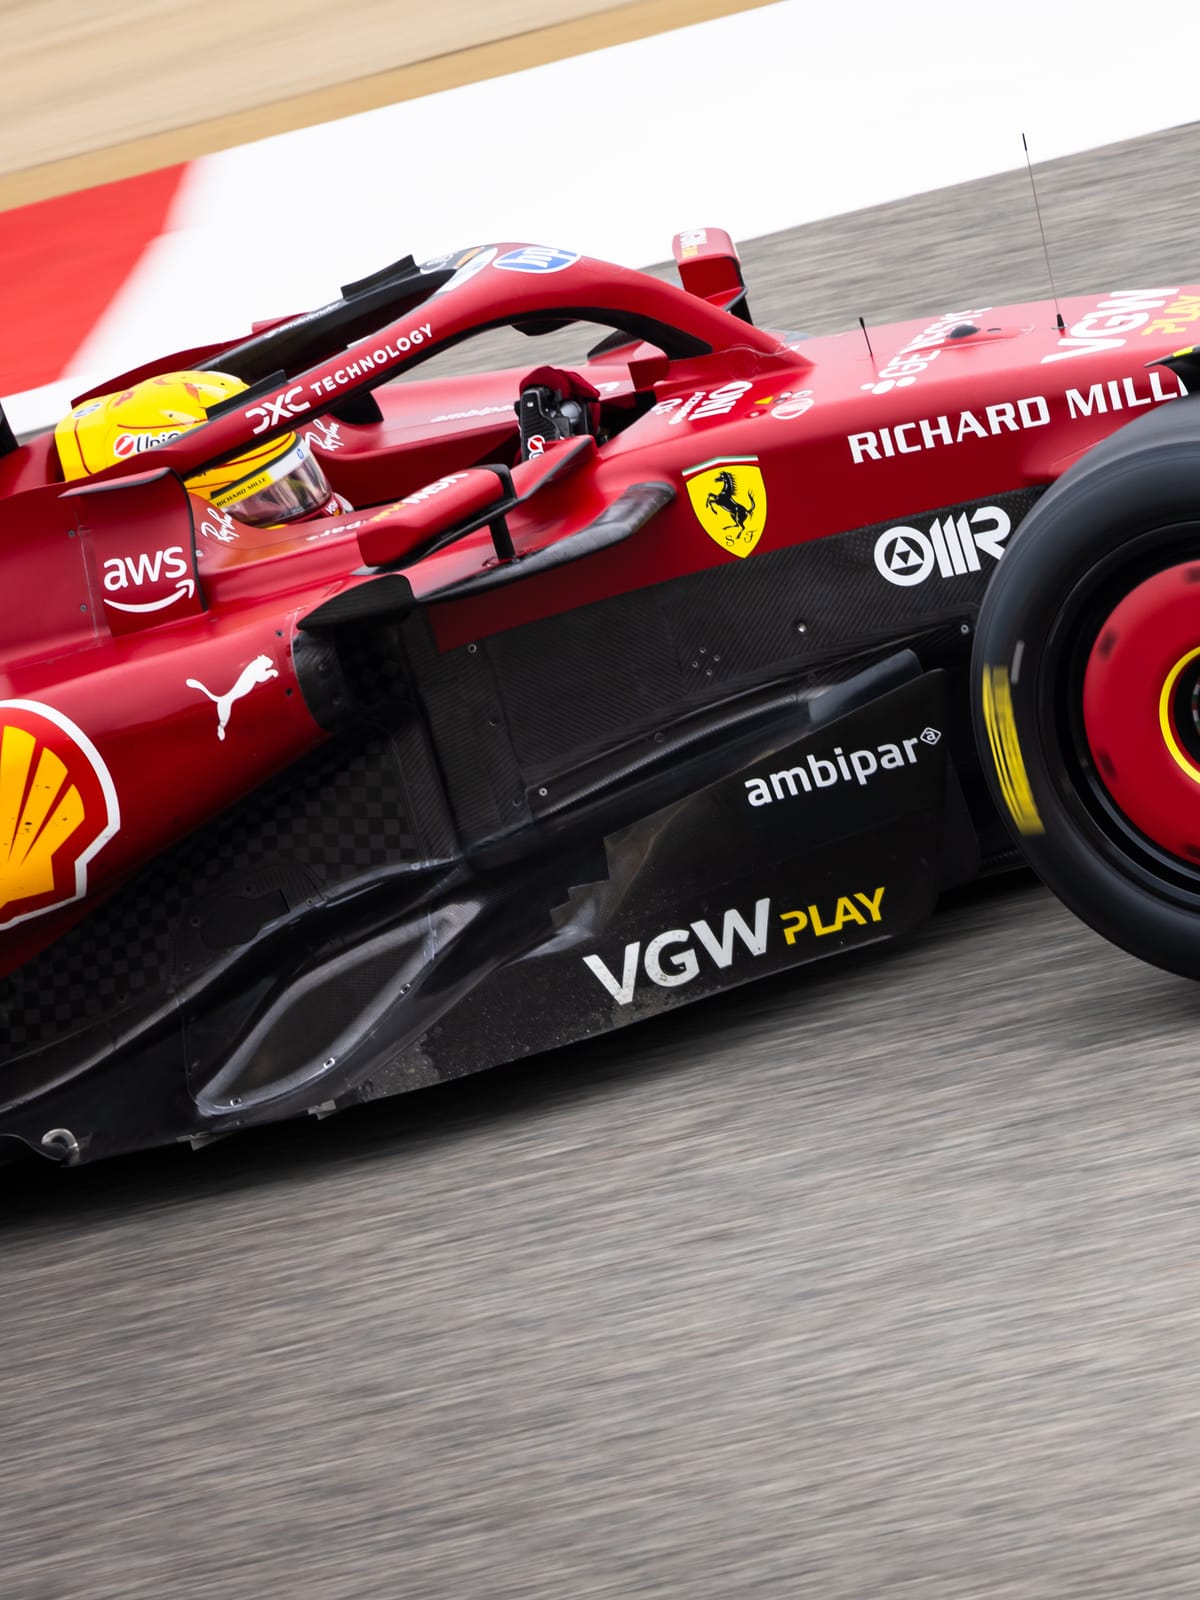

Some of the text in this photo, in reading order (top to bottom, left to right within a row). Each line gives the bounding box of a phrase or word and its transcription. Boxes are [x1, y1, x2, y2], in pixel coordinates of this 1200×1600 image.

[1041, 288, 1180, 363] VGW
[246, 323, 433, 435] DXC TECHNOLOGY
[848, 396, 1051, 464] RICHARD
[103, 546, 188, 591] aws
[744, 735, 918, 807] ambipar
[583, 887, 886, 1006] VGW PLAY
